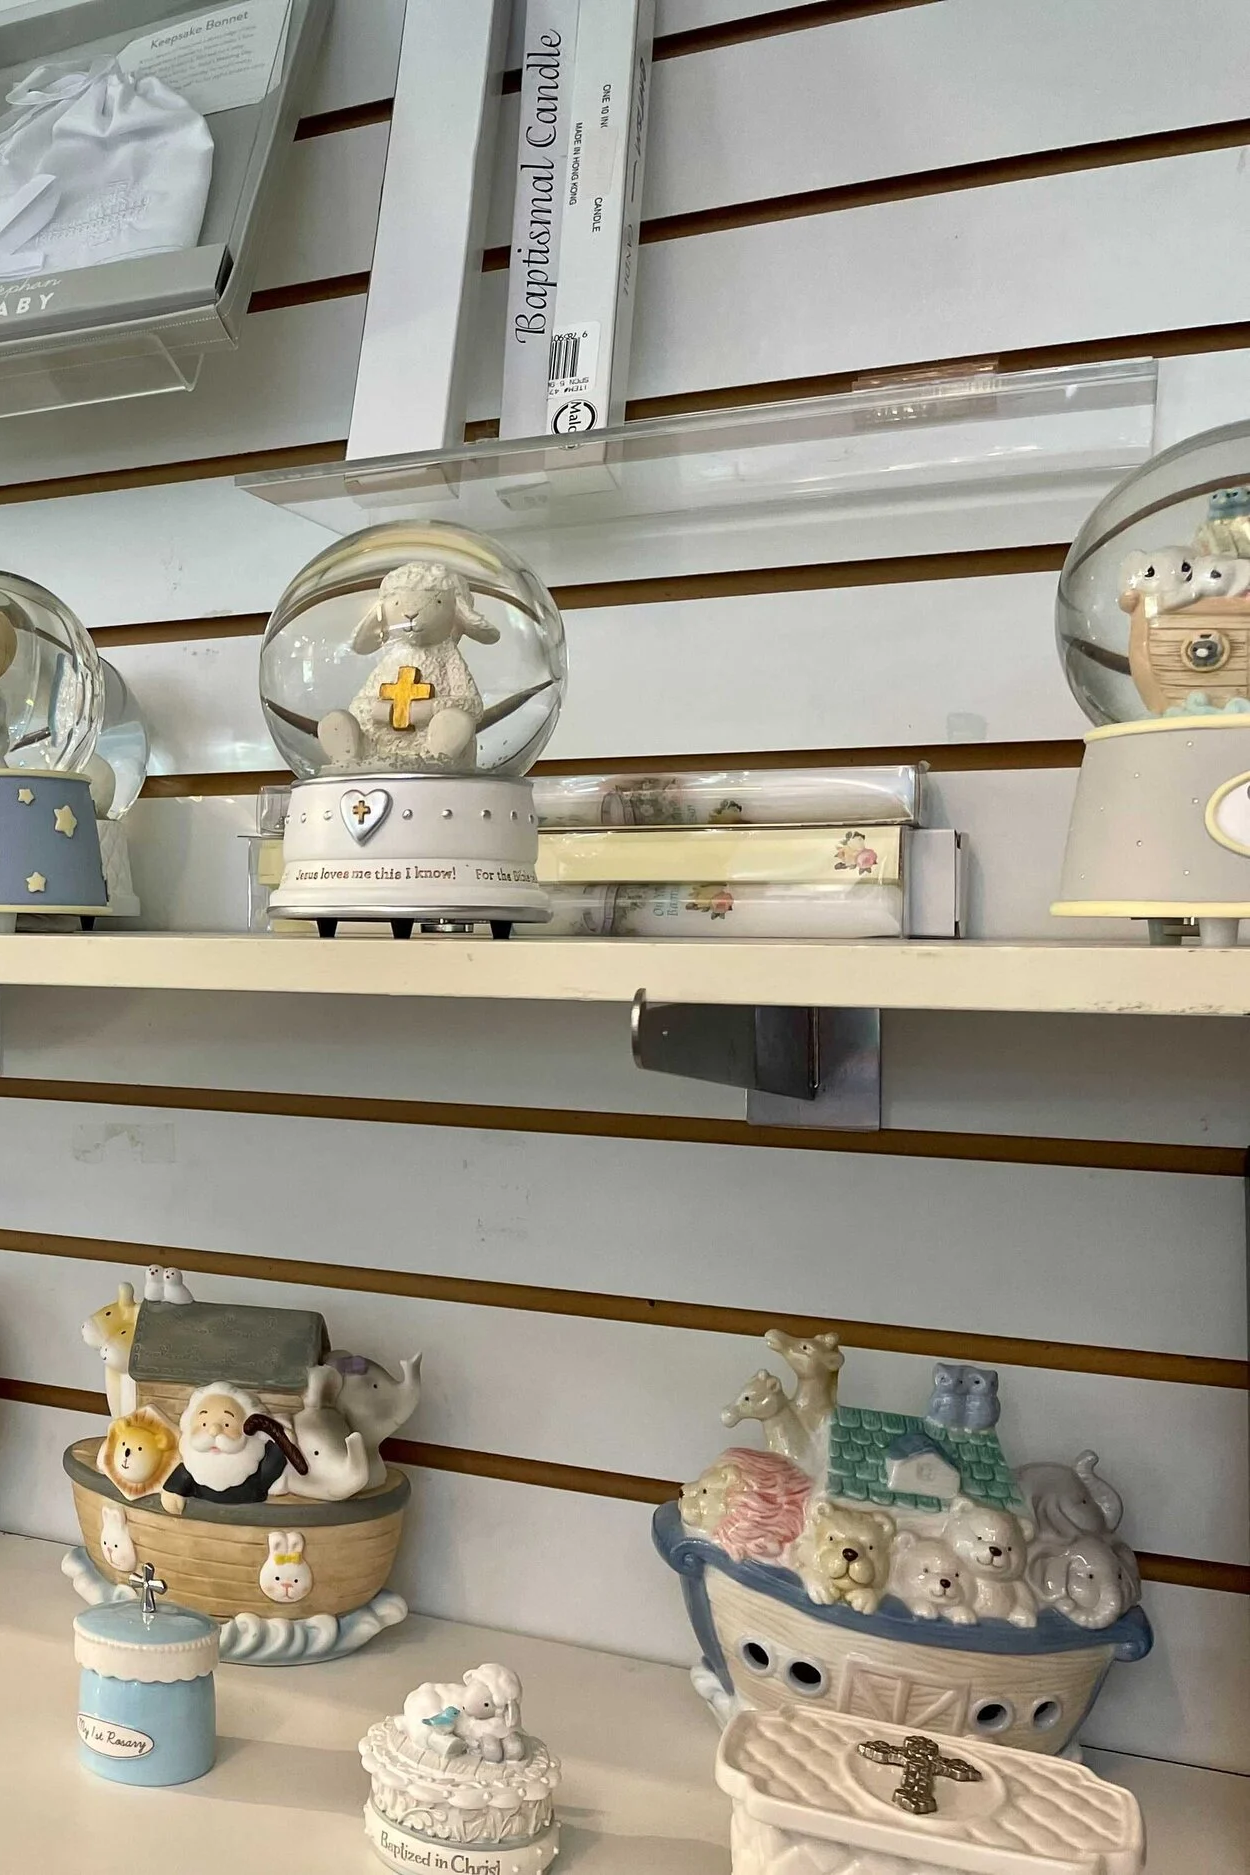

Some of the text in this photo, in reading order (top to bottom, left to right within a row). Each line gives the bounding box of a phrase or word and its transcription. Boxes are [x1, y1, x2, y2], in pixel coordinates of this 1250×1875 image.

[150, 11, 248, 49] Keepsake Bonnet
[600, 105, 609, 115] 10
[601, 84, 611, 104] ONE
[569, 123, 583, 205] MADE IN HONG KONG
[515, 29, 561, 343] Baptismal Candle
[592, 197, 603, 232] CANDLE
[296, 866, 456, 881] Jesus loves me this I know!
[475, 868, 494, 881] For
[496, 867, 512, 881] the
[78, 1717, 90, 1740] My
[107, 1731, 147, 1754] Rosary
[380, 1830, 501, 1875] Baptized in Christ
